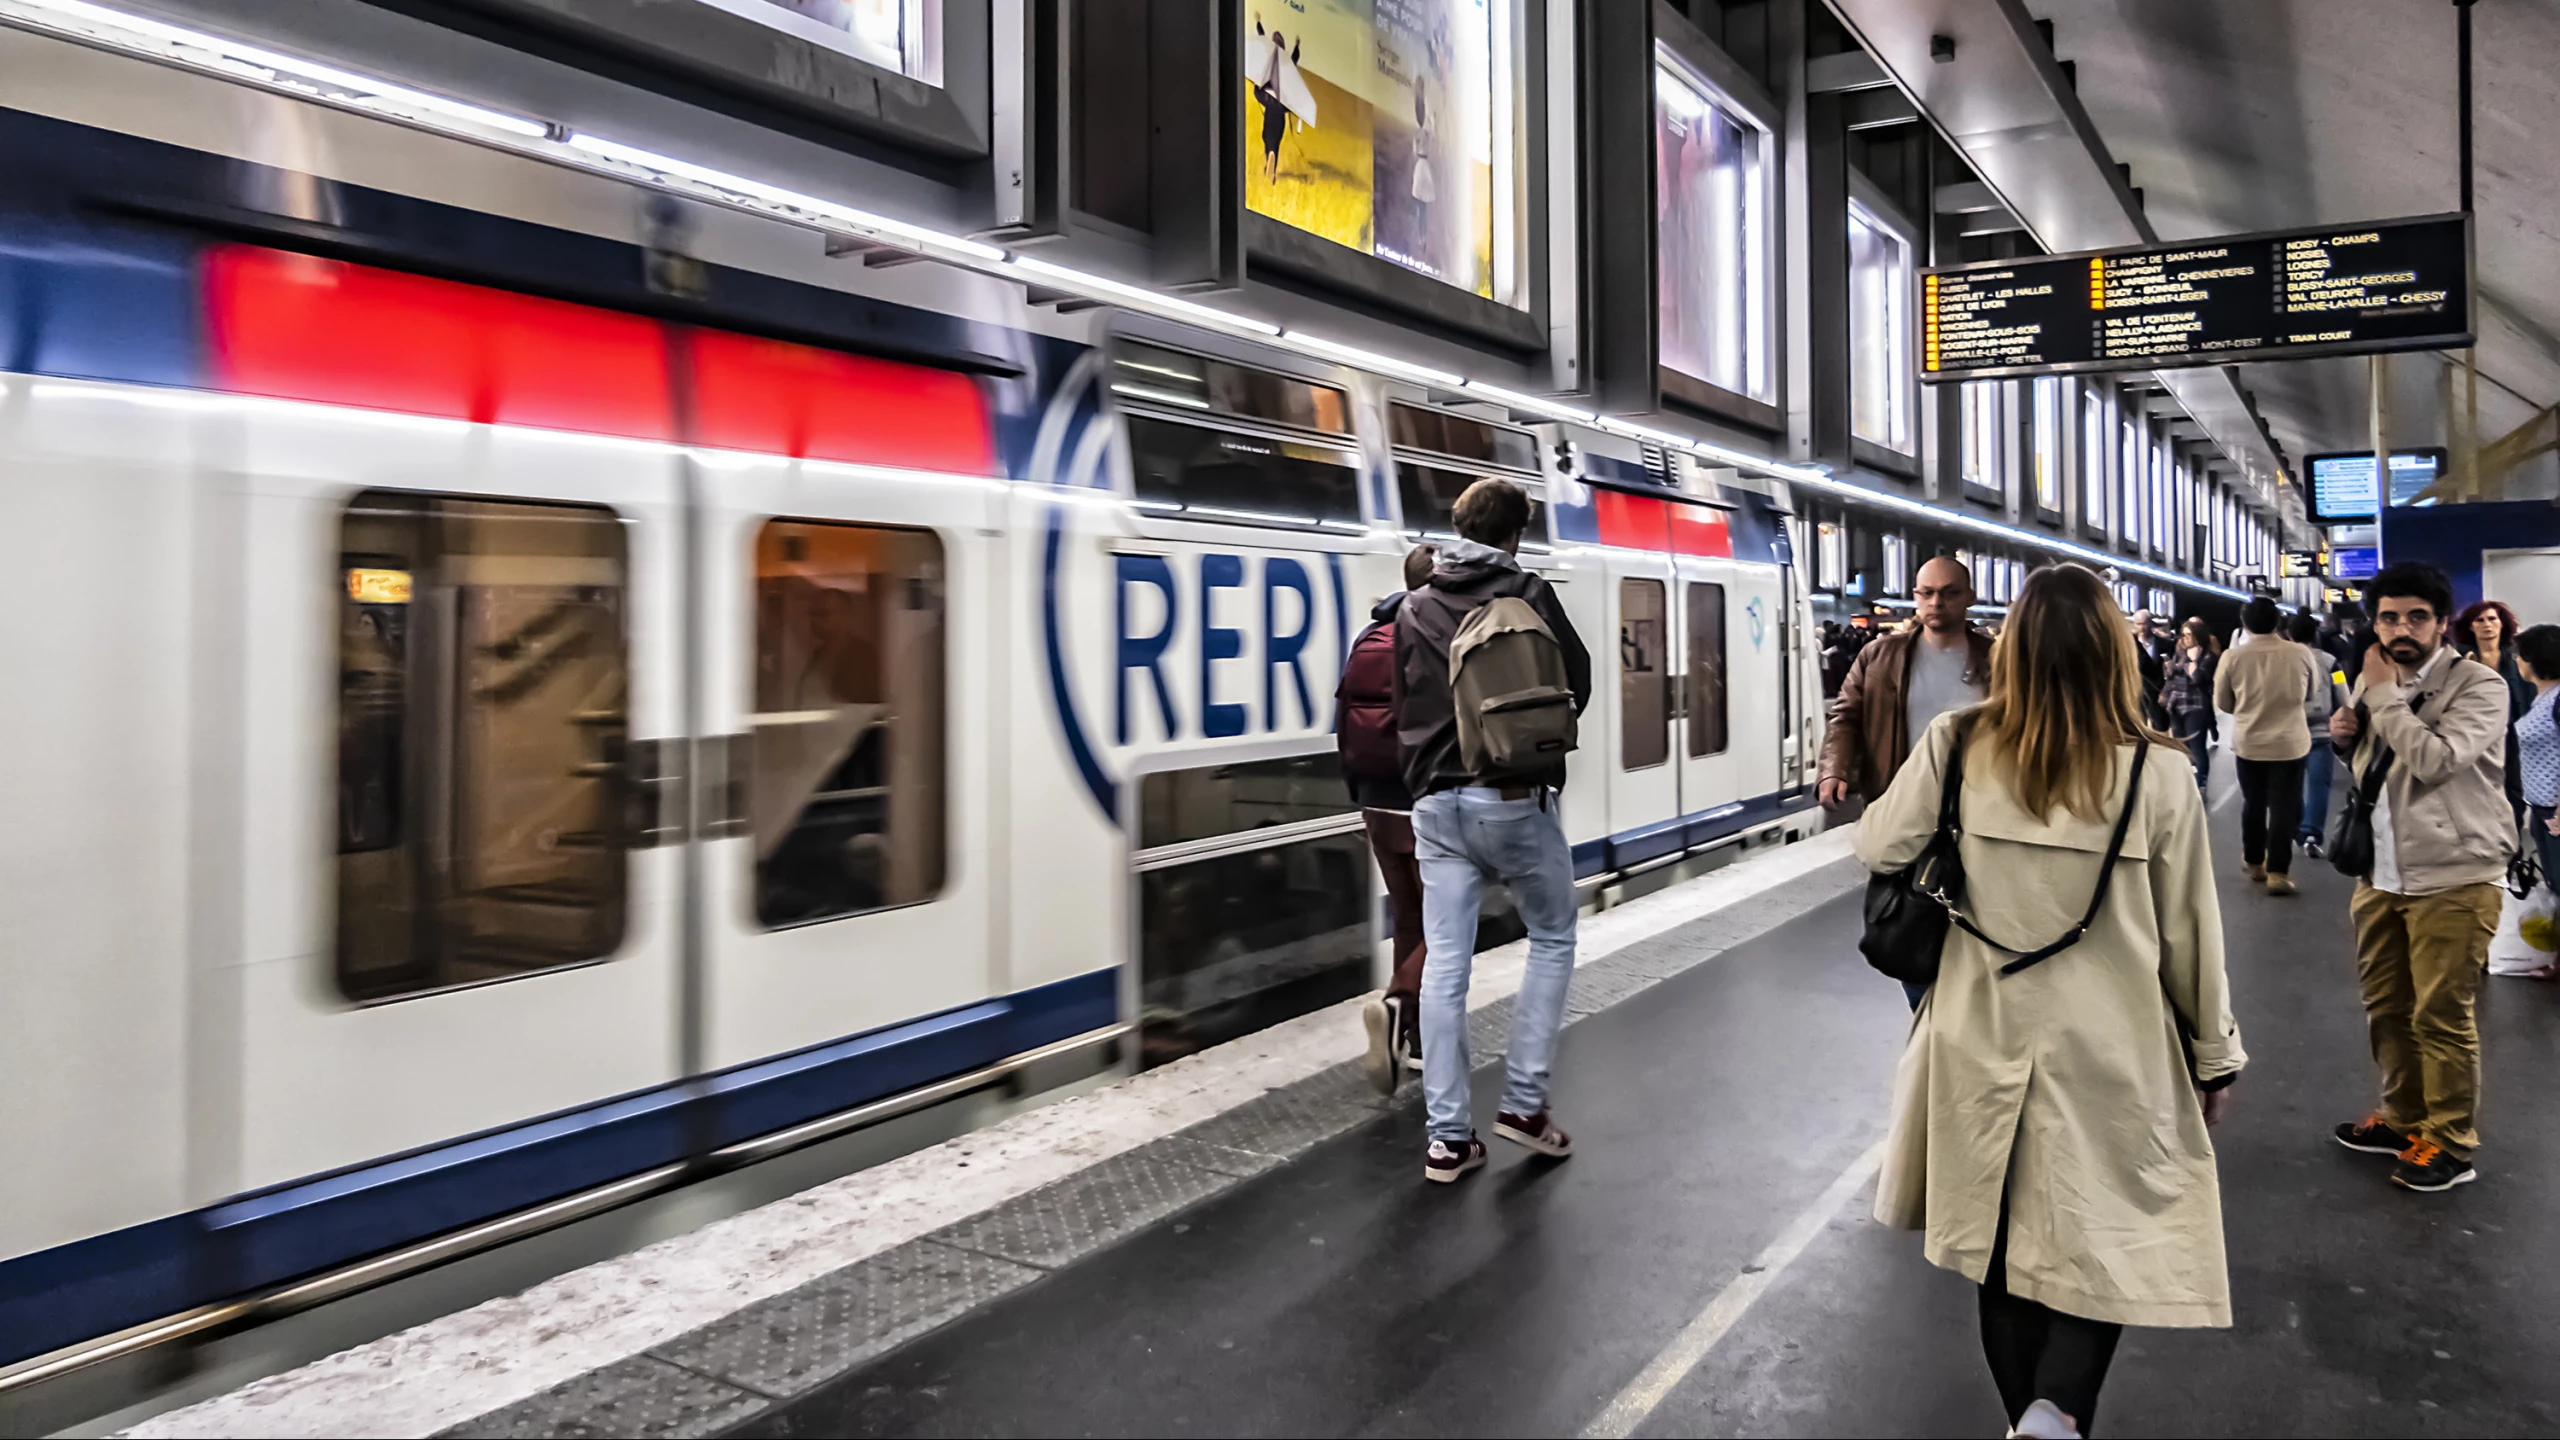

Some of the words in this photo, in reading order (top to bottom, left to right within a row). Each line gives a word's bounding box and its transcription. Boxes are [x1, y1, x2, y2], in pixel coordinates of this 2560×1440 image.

[2286, 239, 2319, 250] NOISY
[2331, 232, 2380, 246] CHAMPS
[2105, 259, 2117, 268] LE
[2120, 257, 2146, 266] PARC
[2149, 255, 2162, 264] DE
[2165, 248, 2228, 262] SAINT-MAUR
[2286, 249, 2328, 261] NOISIEL
[2105, 265, 2163, 278] CHAMPIGNY
[2286, 258, 2331, 271] LOGNES
[2105, 279, 2119, 288] LA
[2121, 274, 2167, 286] VARENNE
[2287, 269, 2325, 281] TORCY
[2287, 271, 2417, 292] BUSSY-SAINT-GEORGES
[2105, 288, 2133, 298] SUCY
[2105, 290, 2209, 309] BOISSY-SAINT-LEGER
[2287, 292, 2307, 302] VAL
[1966, 301, 1980, 311] DE
[2287, 294, 2388, 313] MARNE-LA-VALLEE
[2400, 291, 2447, 303] CHESSY
[1939, 312, 1972, 322] NATION
[2105, 318, 2124, 327] VAL
[2126, 316, 2141, 326] DE
[2143, 311, 2197, 324] FONTENAY
[2105, 332, 2188, 348] BRY-SUR-MARNE
[2288, 333, 2317, 343] TRAIN
[2318, 330, 2352, 341] COURT
[2105, 343, 2190, 358] NOISY-LE-GRAND
[1114, 551, 1316, 746] RER
